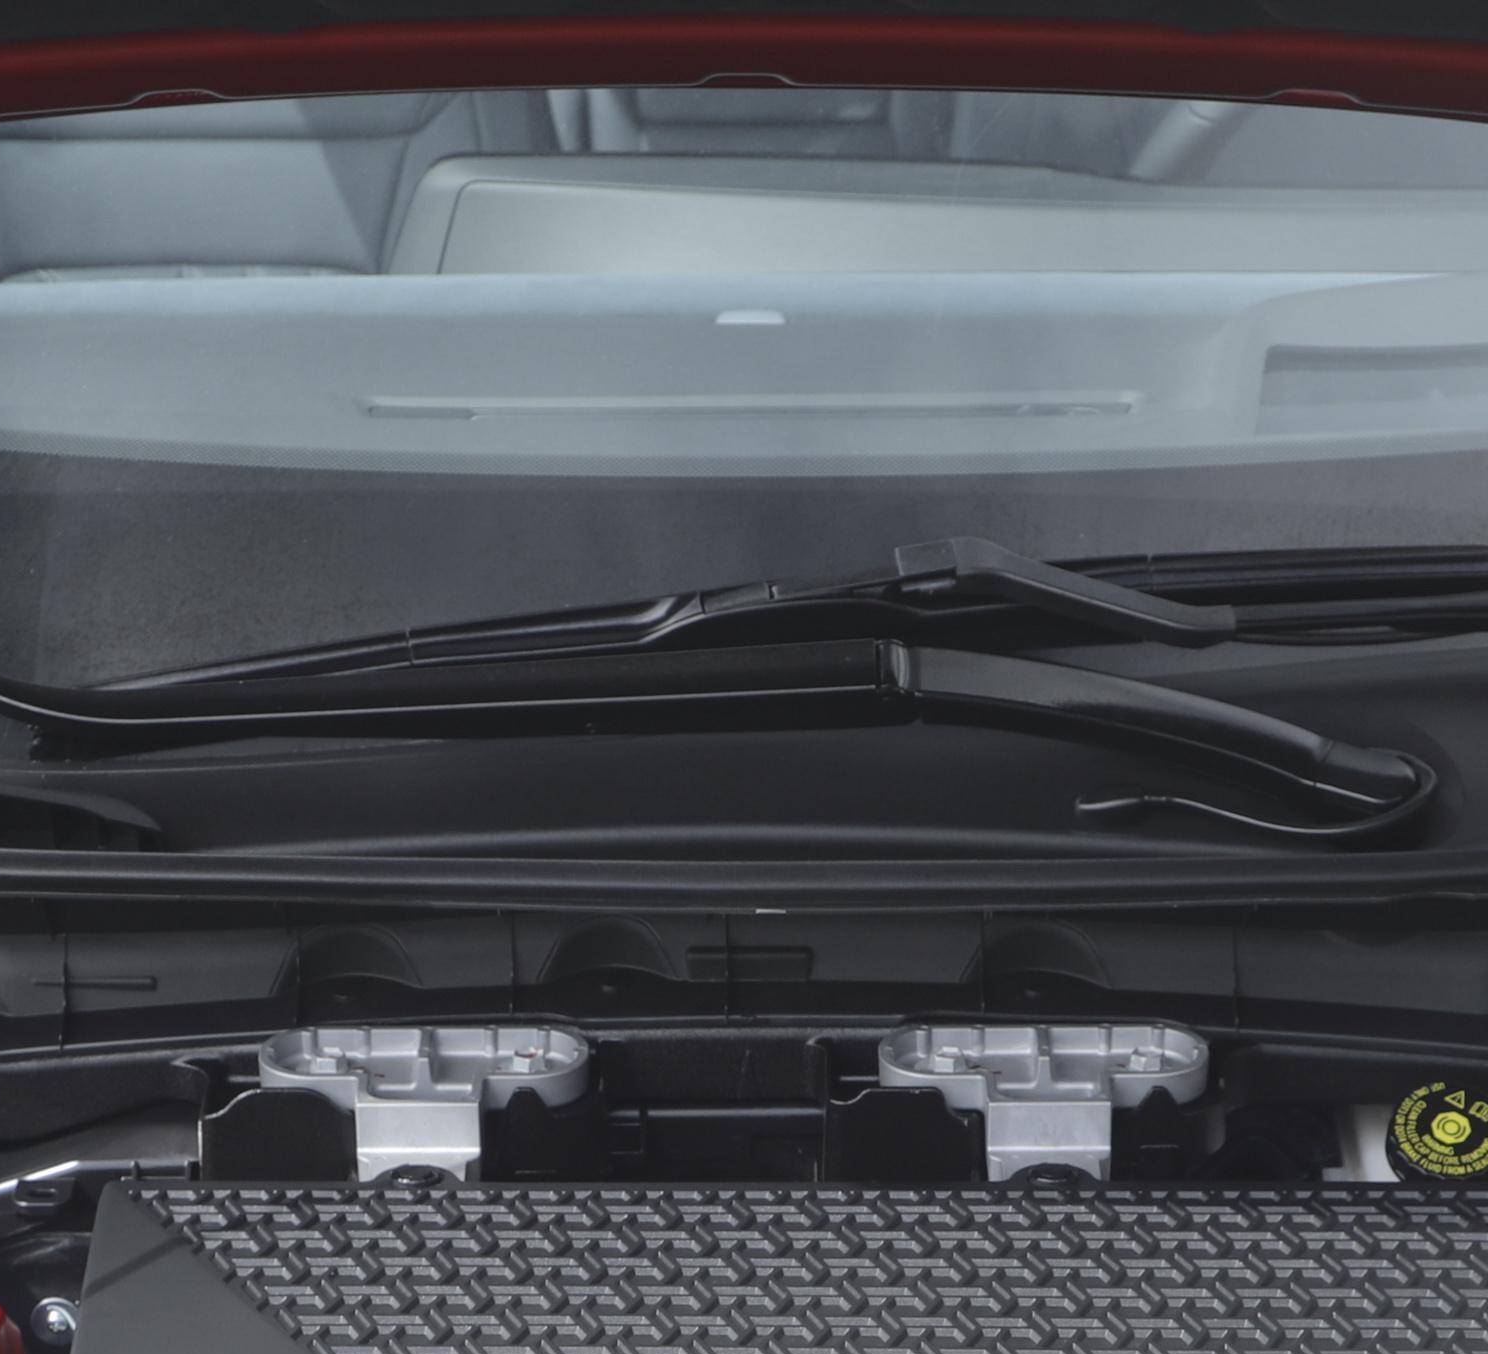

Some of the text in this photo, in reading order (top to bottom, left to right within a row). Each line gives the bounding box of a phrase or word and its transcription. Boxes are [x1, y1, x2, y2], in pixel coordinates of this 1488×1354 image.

[1407, 1100, 1427, 1120] CLEAN
[1406, 1120, 1420, 1143] FILLER
[1415, 1141, 1431, 1155] CAP
[1419, 1158, 1442, 1173] FLUID
[1442, 1164, 1466, 1175] FROM
[1428, 1151, 1460, 1165] BEFORE
